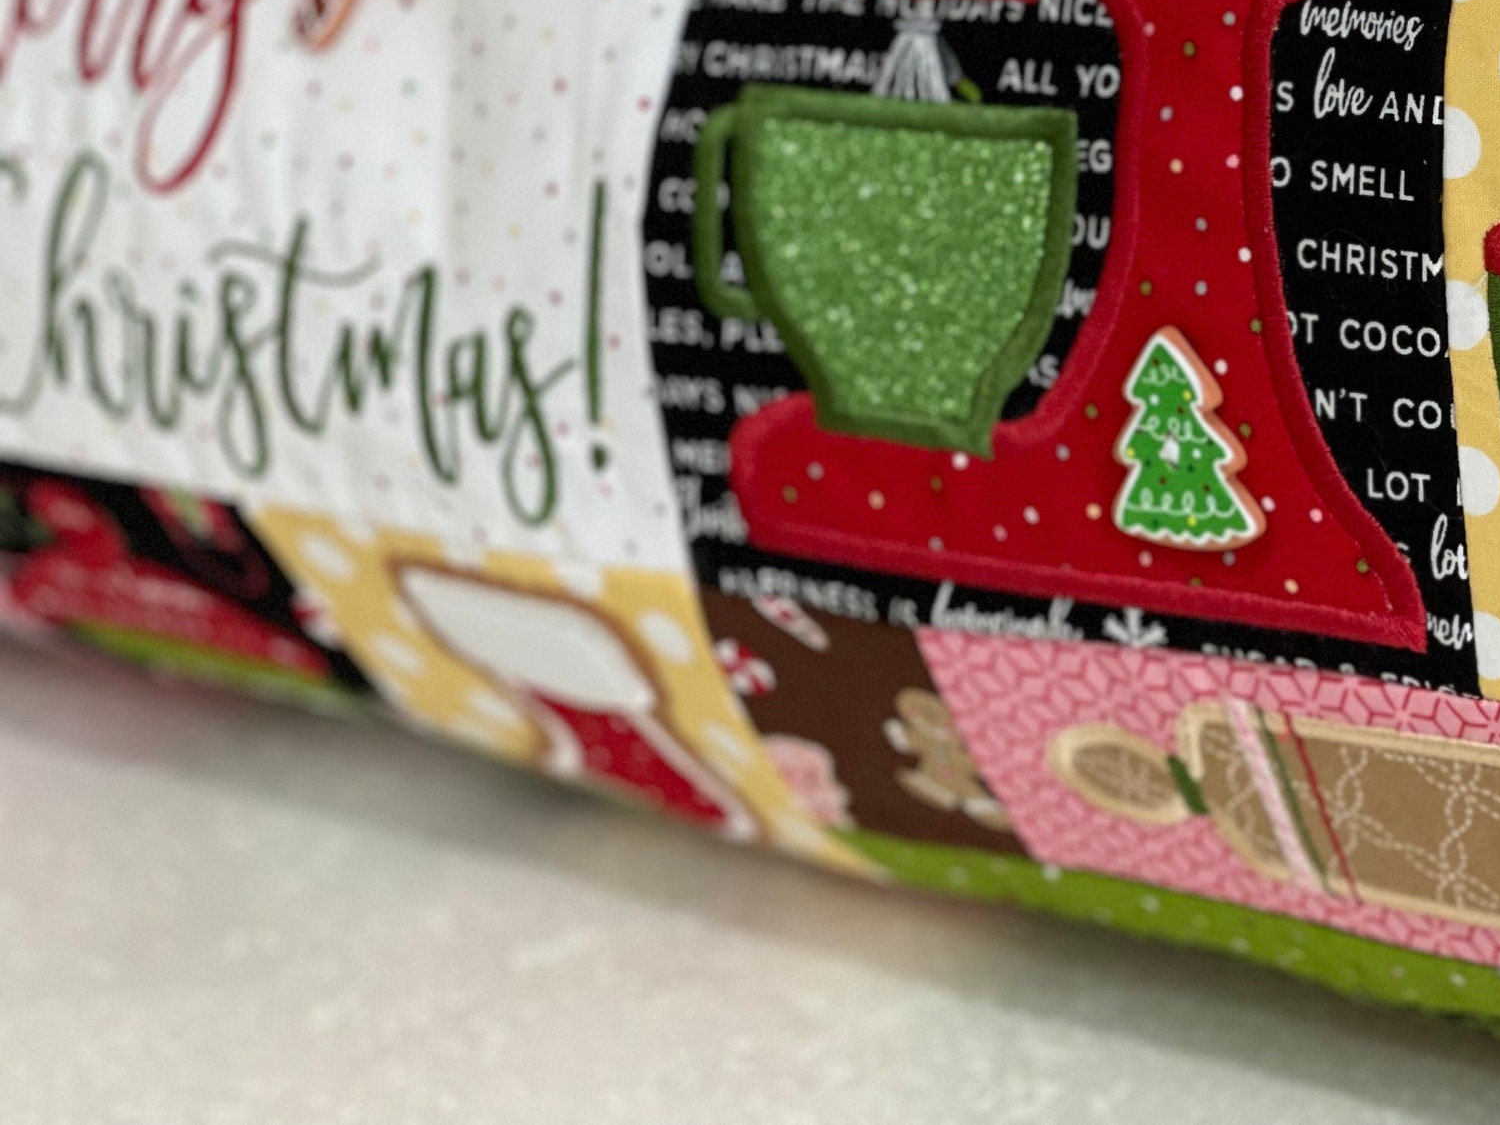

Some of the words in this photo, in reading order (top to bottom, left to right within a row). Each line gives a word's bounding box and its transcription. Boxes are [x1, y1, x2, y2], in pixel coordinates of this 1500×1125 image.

[1300, 0, 1425, 52] memories
[996, 56, 1059, 96] ALL
[1313, 46, 1374, 119] love
[1310, 159, 1415, 201] SMELL
[0, 151, 610, 528] hristmas!
[1339, 318, 1449, 358] COCO
[1314, 387, 1369, 422] N'T
[1393, 397, 1456, 430] CO
[1366, 468, 1432, 503] LOT
